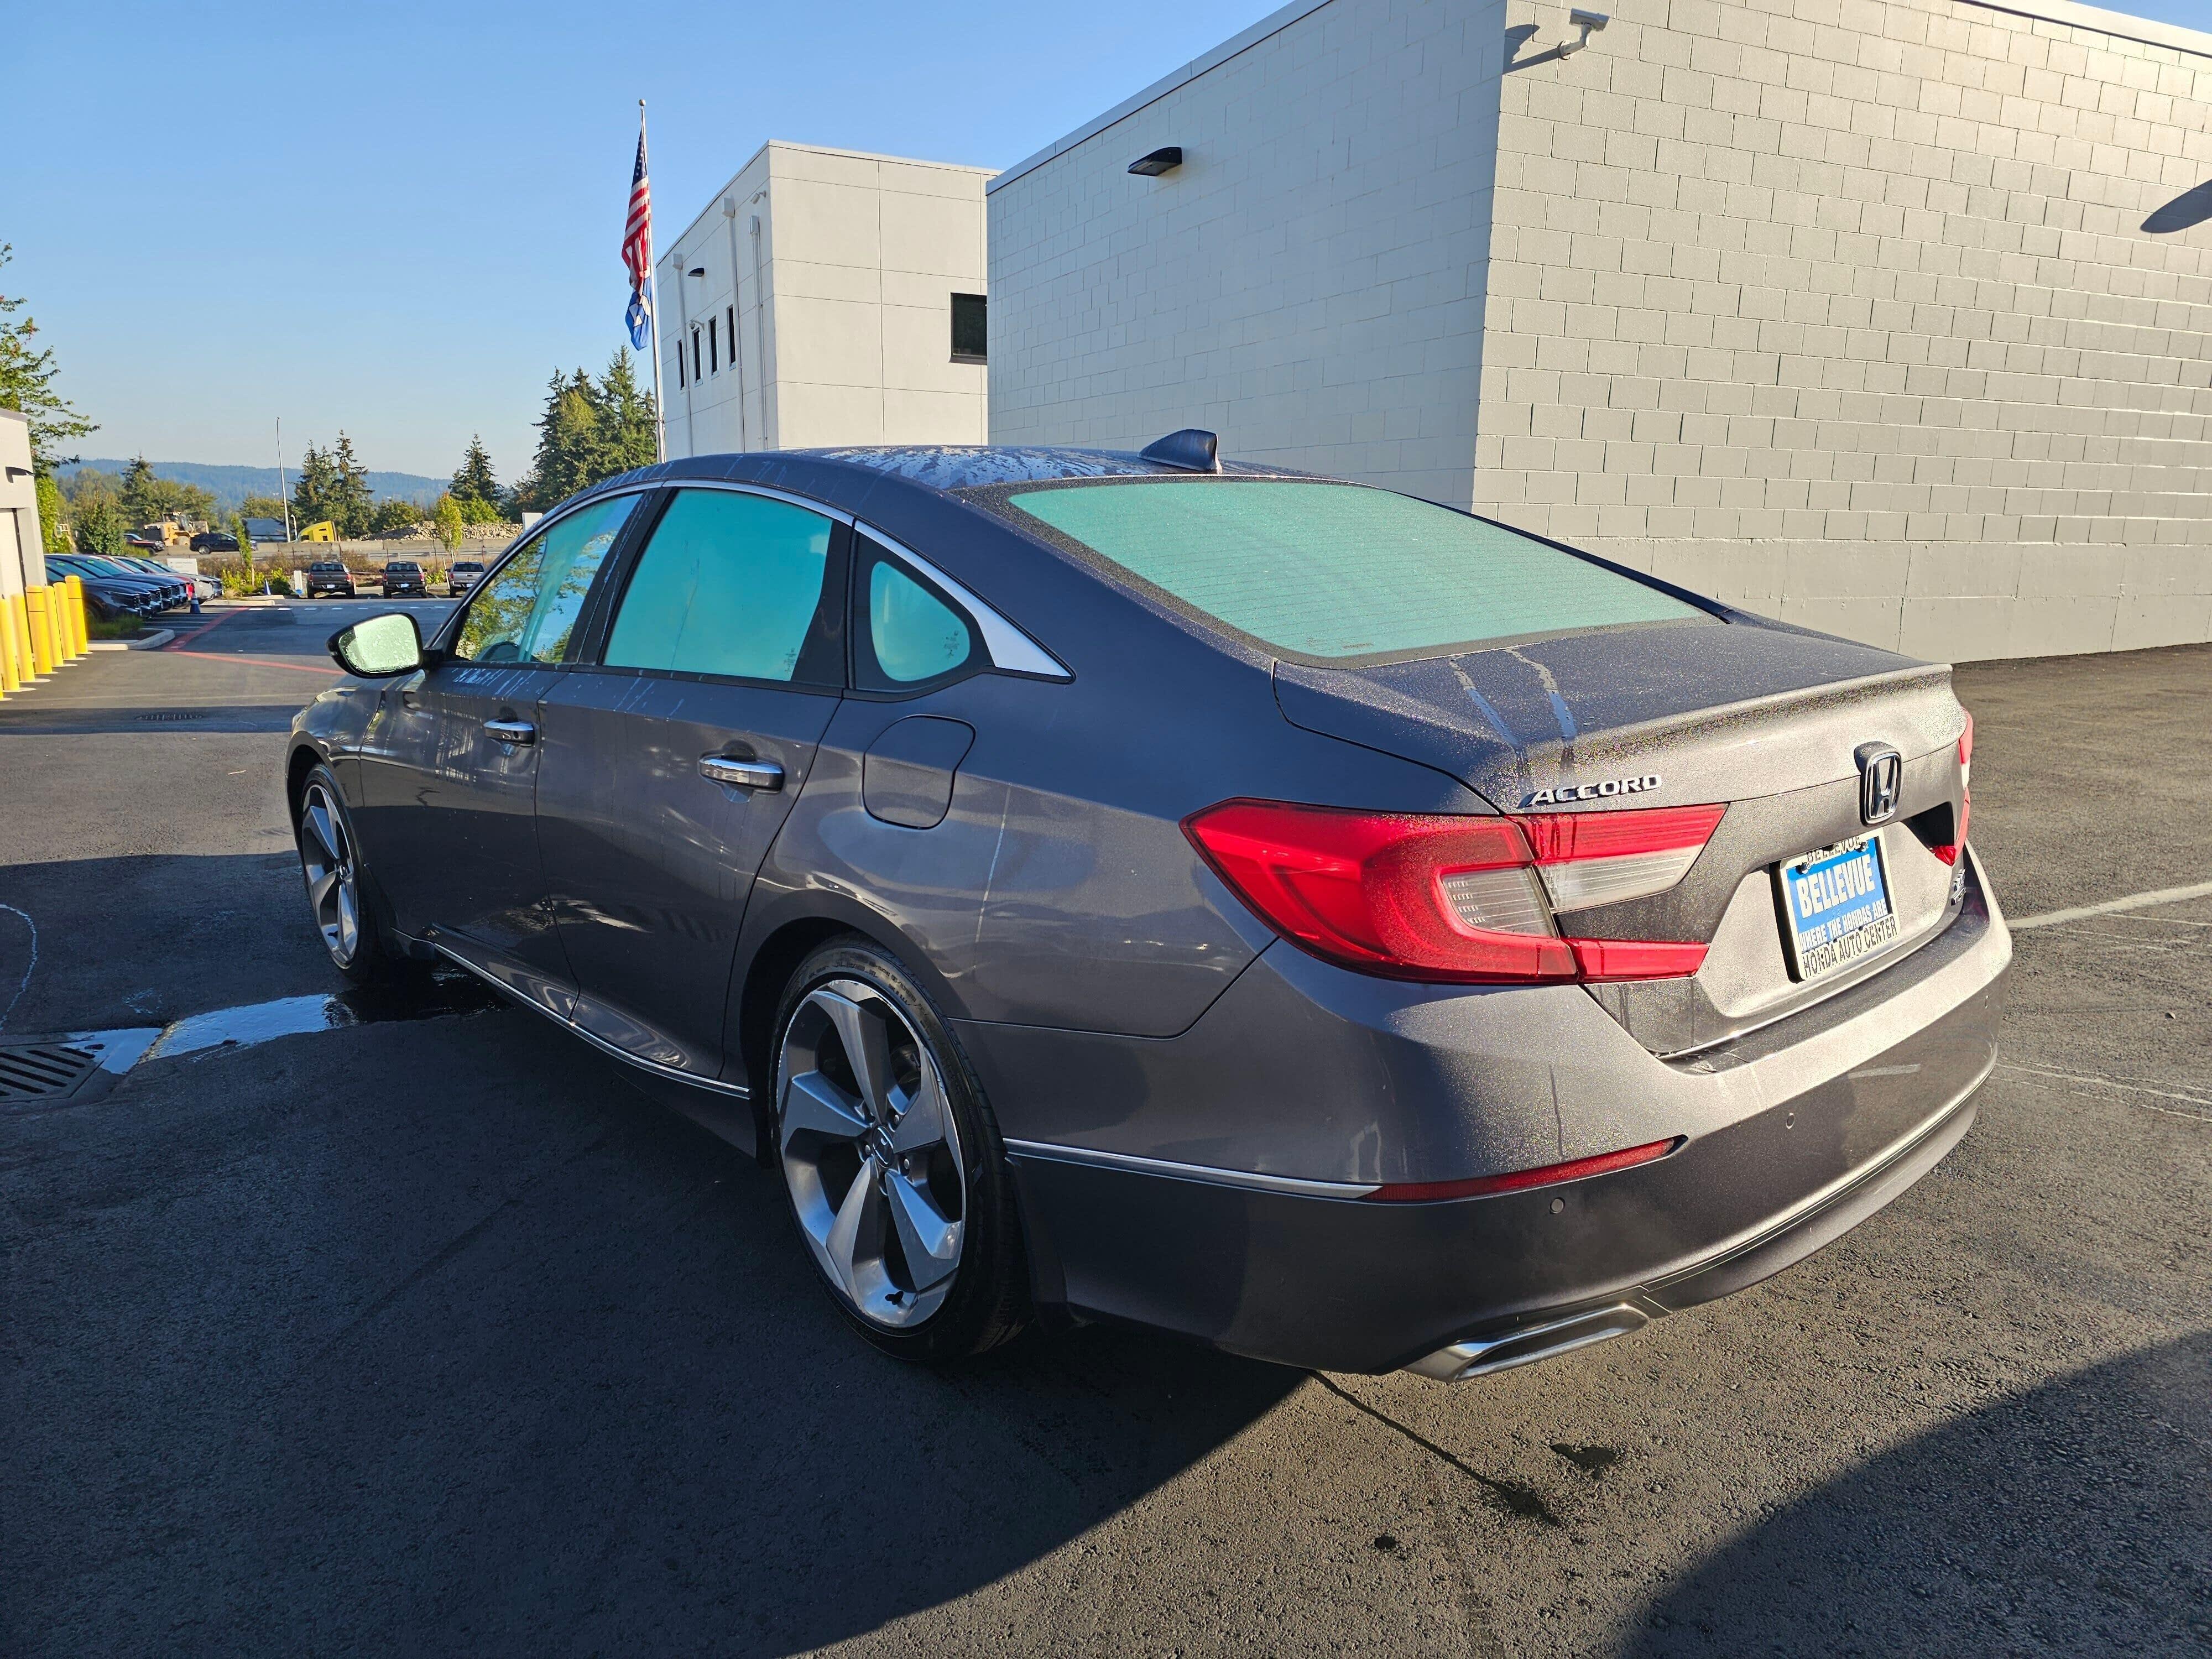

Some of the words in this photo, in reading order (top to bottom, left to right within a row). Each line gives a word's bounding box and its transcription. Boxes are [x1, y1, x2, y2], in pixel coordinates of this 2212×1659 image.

[1526, 774, 1662, 807] ACCORD
[1797, 854, 1875, 918] BELLEVUE
[1798, 924, 1828, 951] WHERE
[1827, 916, 1844, 940] THE
[1841, 904, 1873, 933] HONDAS
[1872, 898, 1888, 920] ARE
[1802, 943, 1838, 979] HONDA
[1838, 931, 1863, 962] AUTO
[1863, 915, 1898, 949] CENTER
